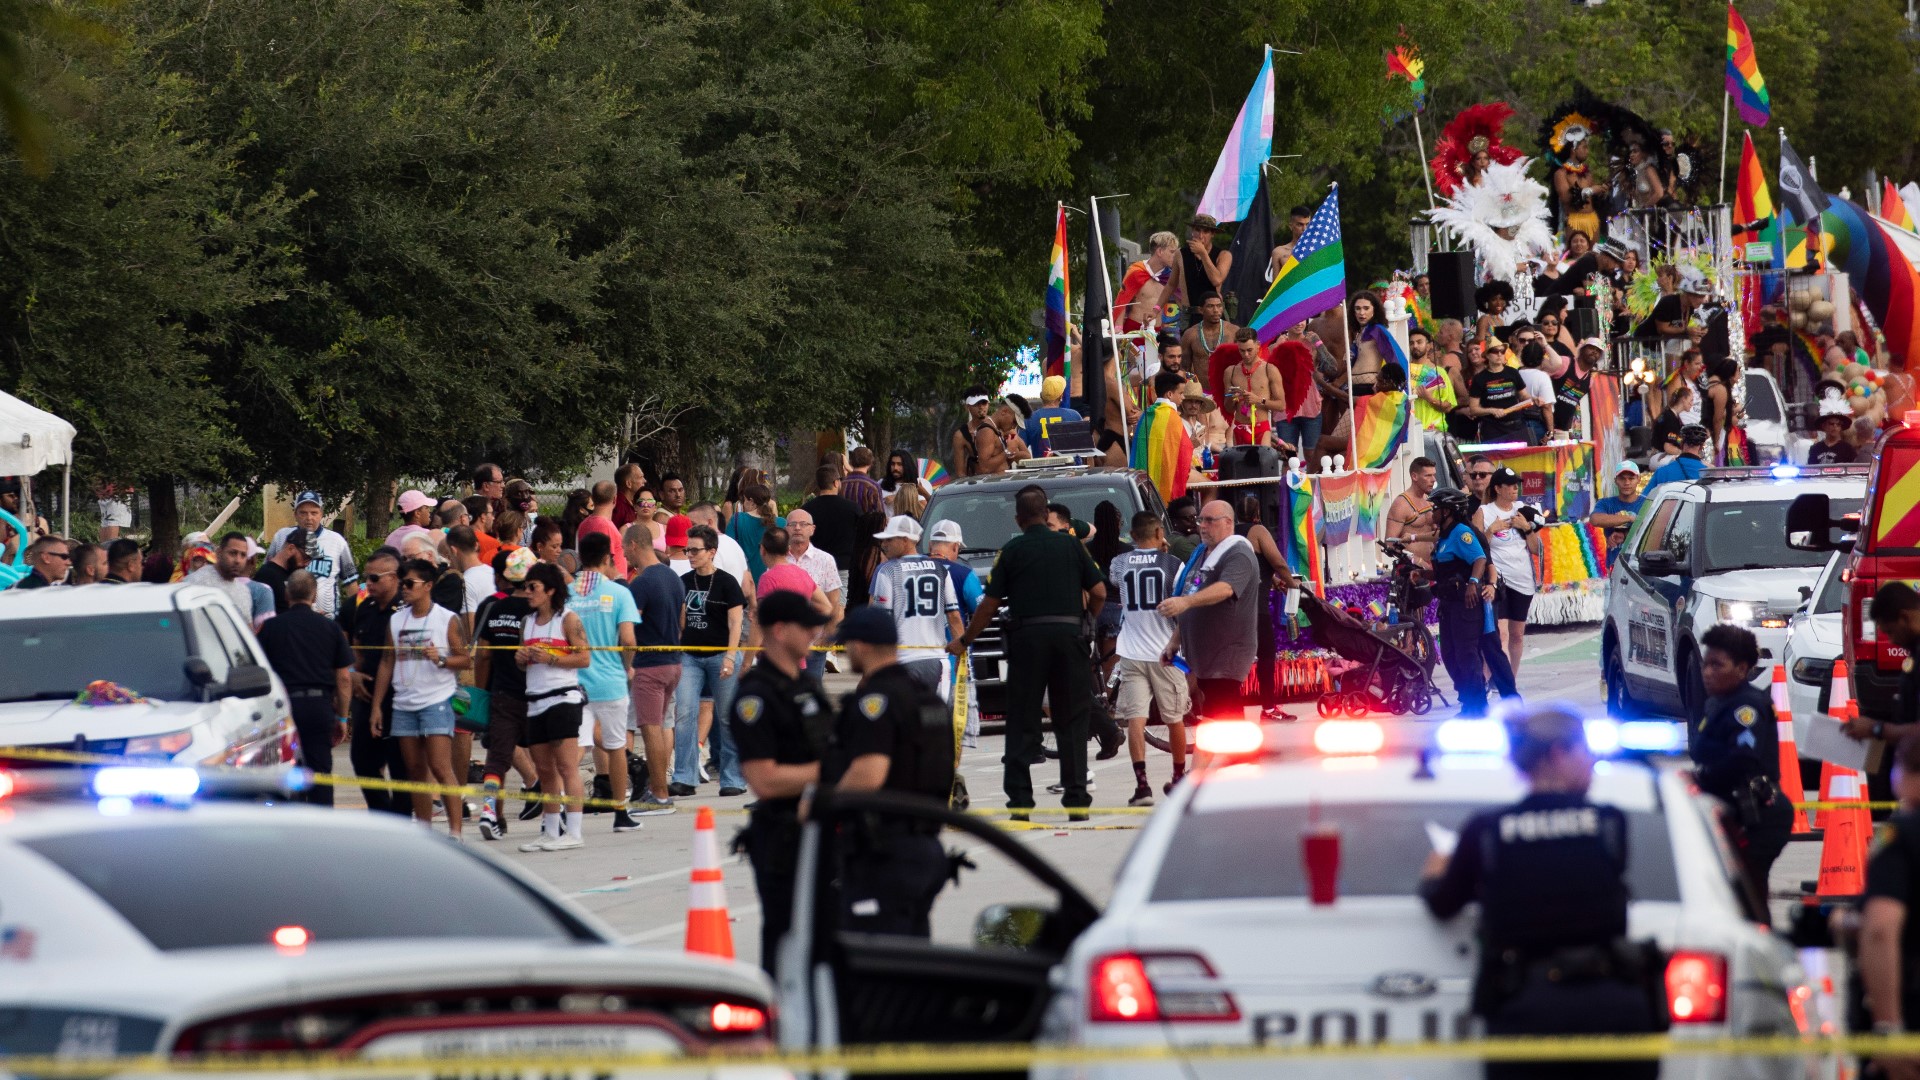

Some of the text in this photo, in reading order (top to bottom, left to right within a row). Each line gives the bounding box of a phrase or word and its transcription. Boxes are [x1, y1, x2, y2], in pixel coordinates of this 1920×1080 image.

[1039, 417, 1062, 439] 1
[1525, 478, 1542, 488] AHF
[900, 560, 936, 572] ROSADO
[1128, 554, 1158, 564] CHAW
[903, 573, 941, 619] 19
[1123, 567, 1165, 612] 10
[488, 618, 521, 629] BROWAR
[1499, 806, 1599, 844] POLICE
